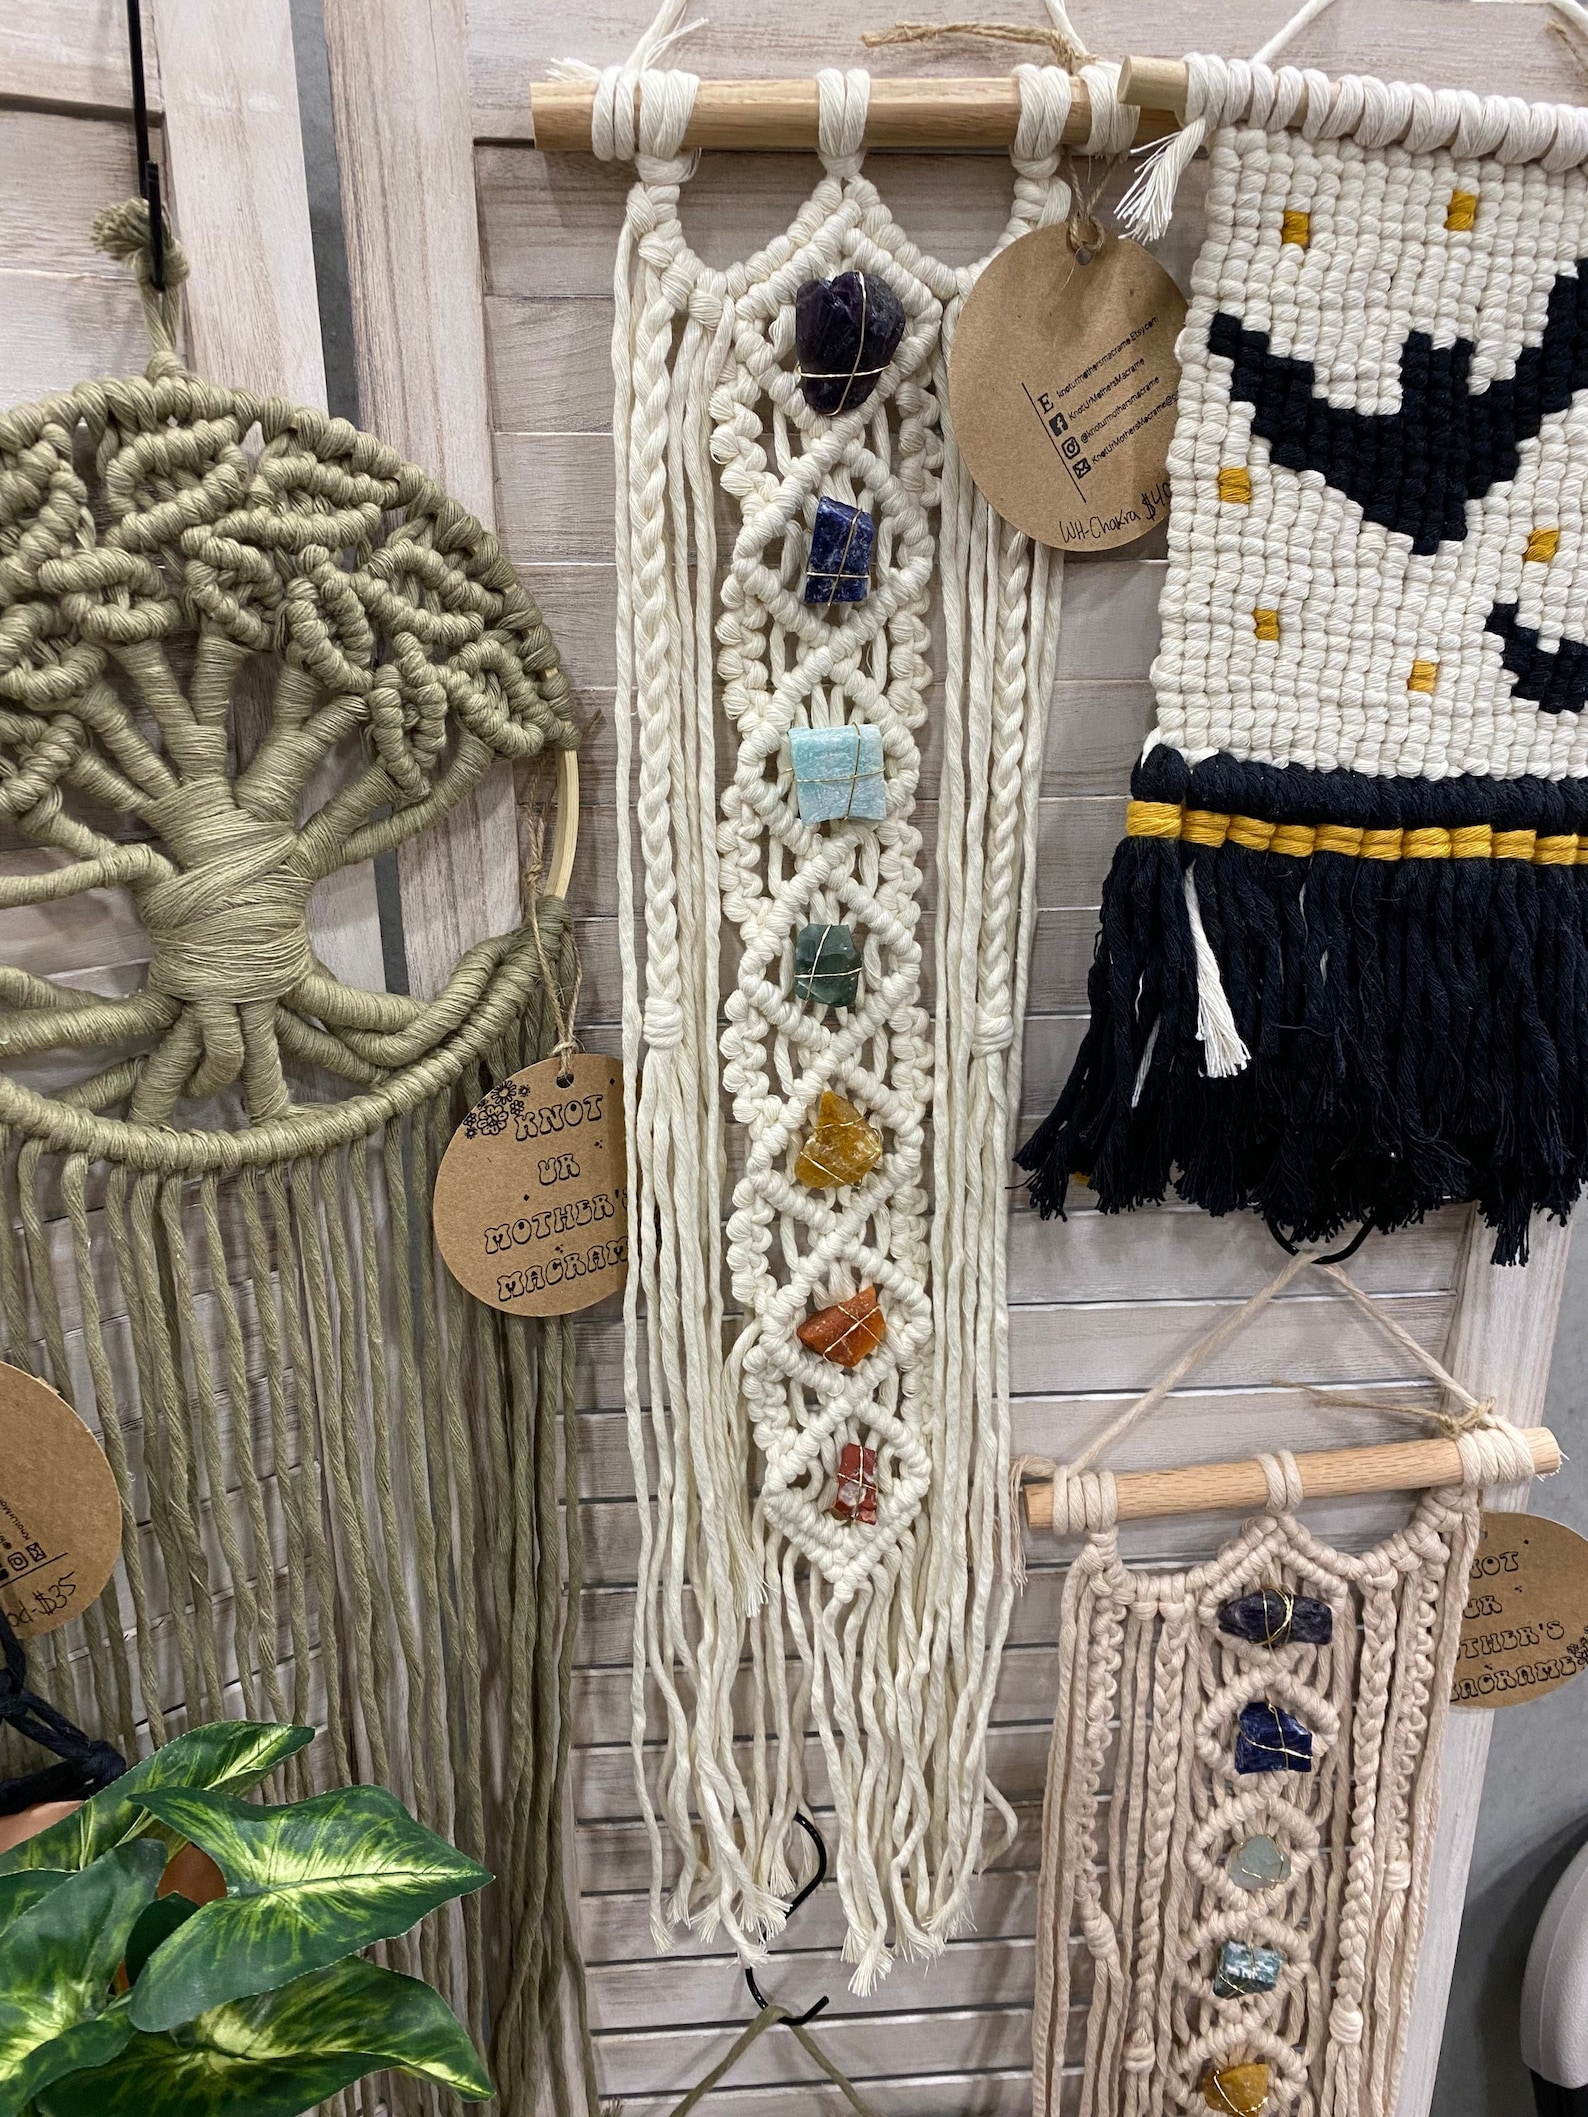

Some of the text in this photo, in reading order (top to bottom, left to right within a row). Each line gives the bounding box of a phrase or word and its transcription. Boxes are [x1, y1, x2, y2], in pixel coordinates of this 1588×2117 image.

[515, 1094, 603, 1141] KNOT
[538, 1154, 580, 1185] UR
[484, 1190, 627, 1254] MOTHER'
[498, 1236, 627, 1301] MACRAM
[1470, 1551, 1519, 1579] NOT
[1457, 1621, 1564, 1661] THER'S
